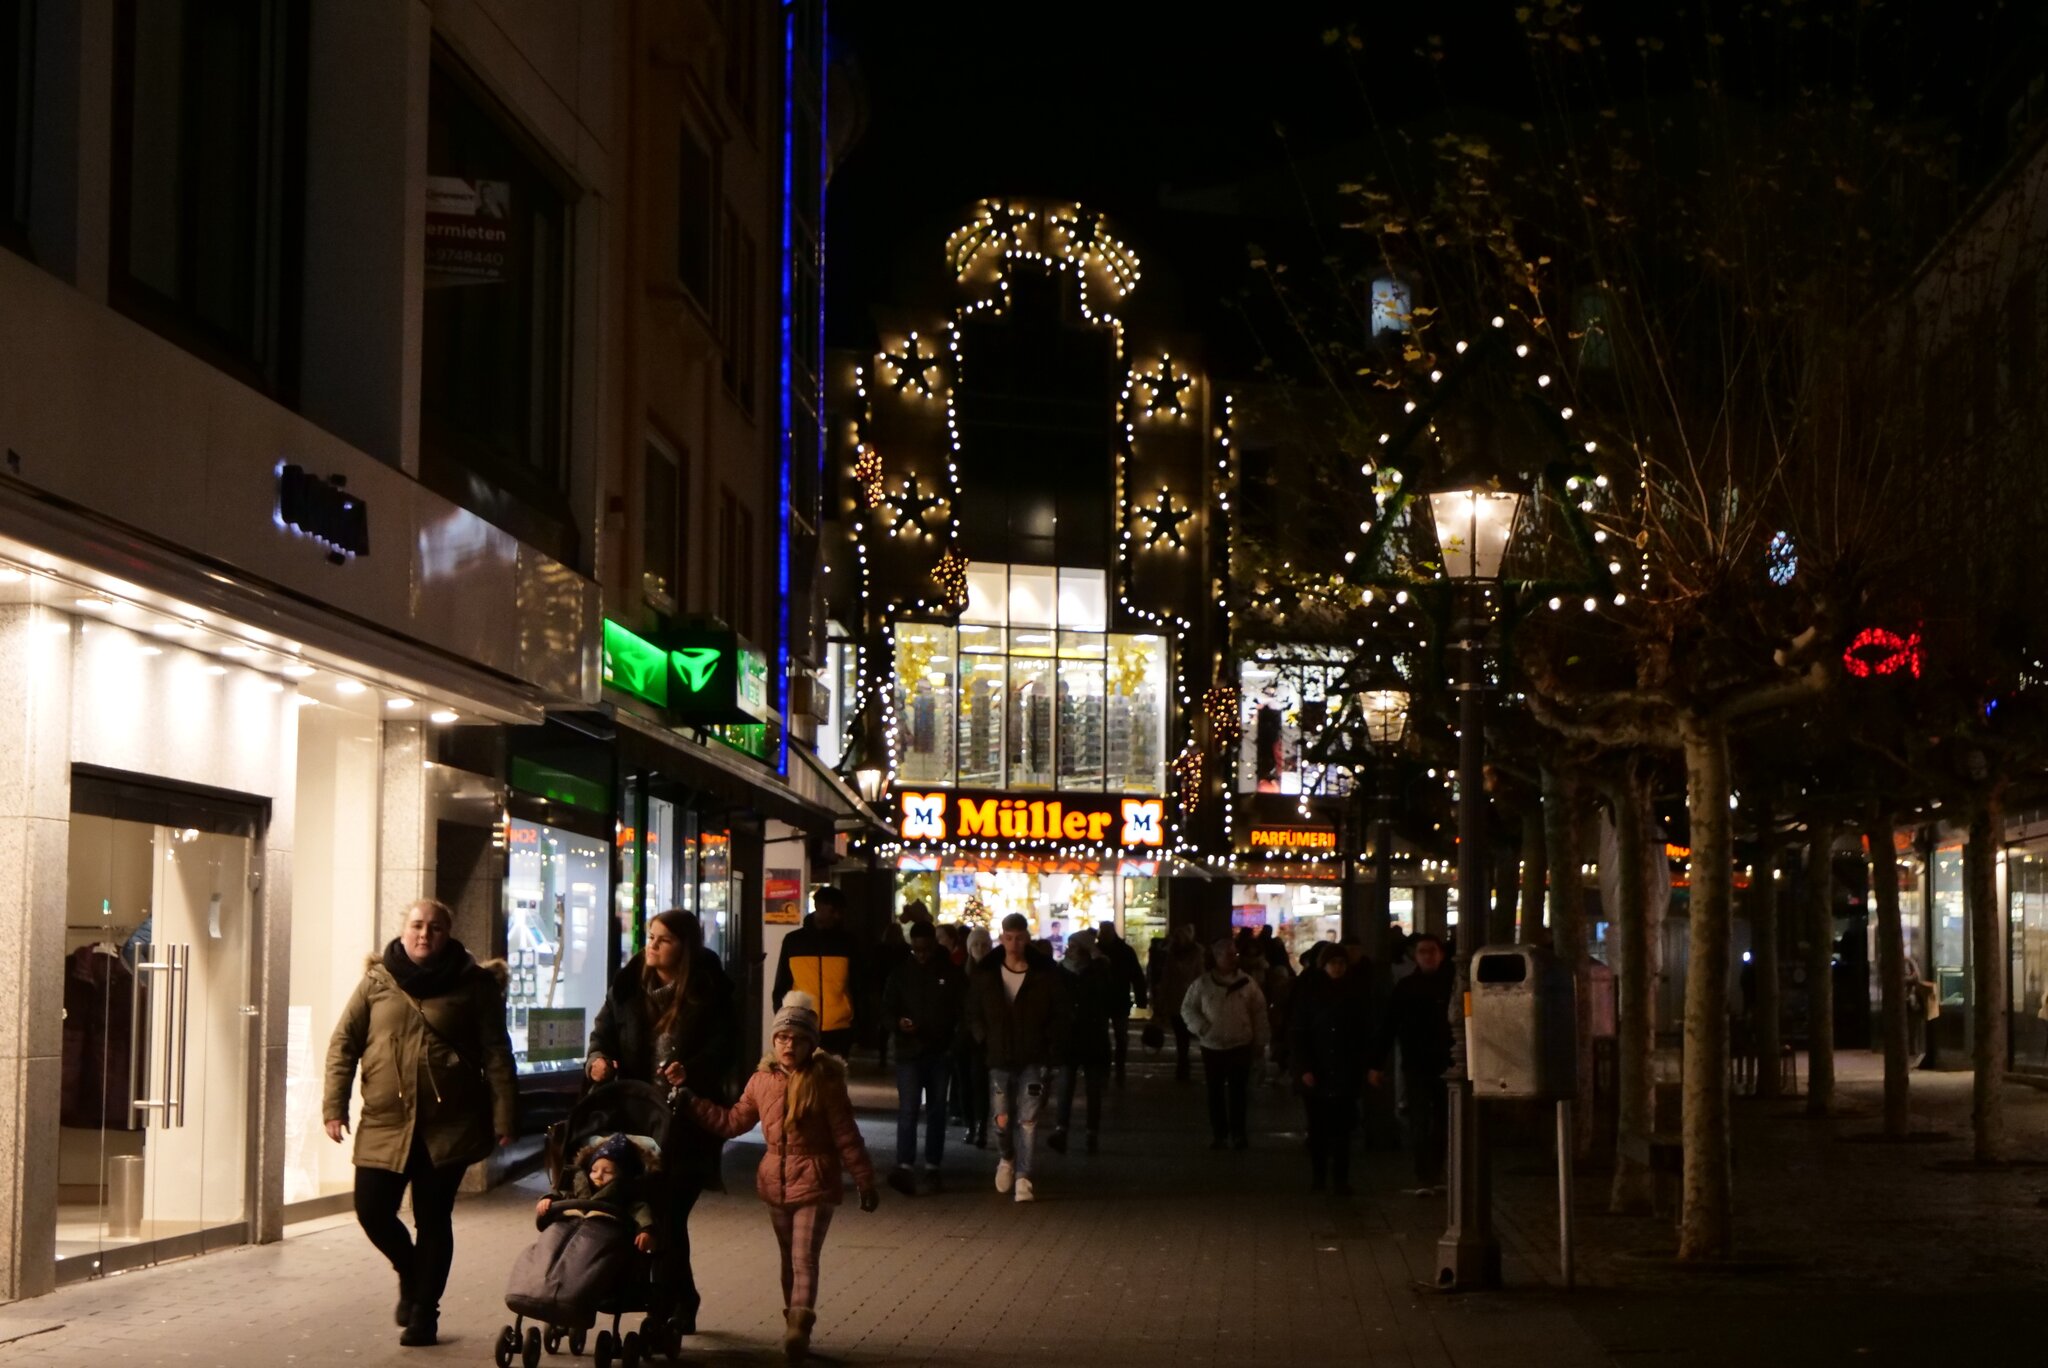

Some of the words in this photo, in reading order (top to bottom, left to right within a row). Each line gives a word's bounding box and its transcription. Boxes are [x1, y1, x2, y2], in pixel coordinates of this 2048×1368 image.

[914, 807, 933, 825] M
[957, 798, 1112, 840] Müller
[1133, 814, 1151, 831] M
